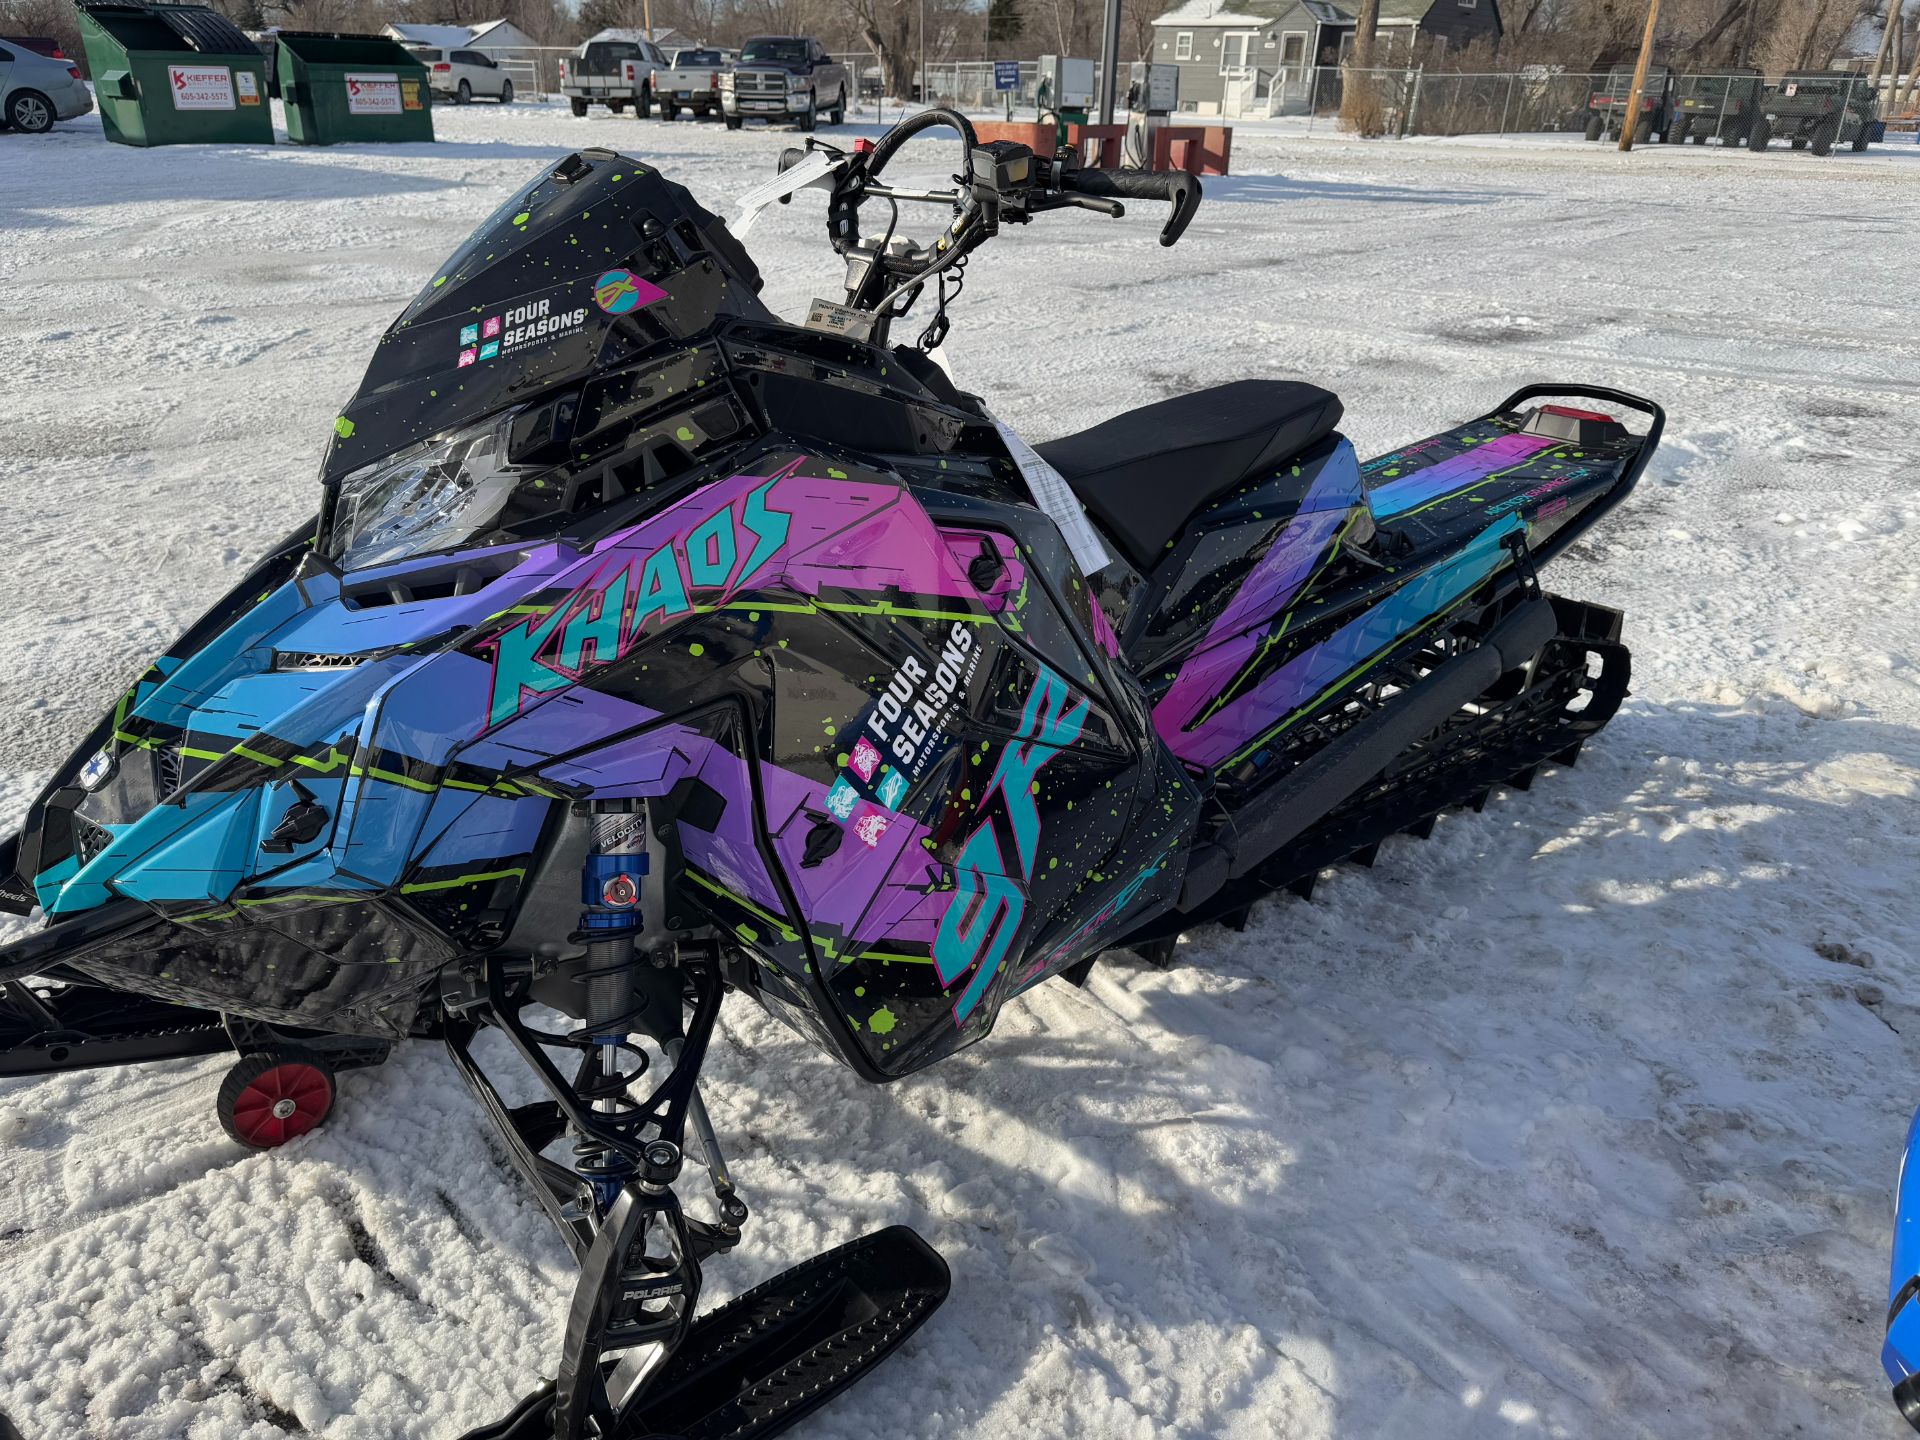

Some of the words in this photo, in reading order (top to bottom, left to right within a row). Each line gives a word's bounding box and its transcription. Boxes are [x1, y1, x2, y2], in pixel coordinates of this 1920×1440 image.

[186, 74, 227, 82] KIEFFER
[181, 92, 228, 101] 605-342-5575
[503, 308, 585, 347] SEASONS
[505, 299, 549, 328] FOUR
[501, 337, 548, 356] MOTORSPORTS
[558, 326, 584, 339] MARINE
[475, 456, 806, 740] KHAOS
[867, 655, 928, 742] FOUR
[892, 621, 972, 765] SEASONS
[912, 703, 960, 777] MOTORSPORS
[958, 690, 966, 700] &
[963, 643, 983, 687] MARINE
[601, 819, 643, 848] VELOCITY
[0, 889, 28, 902] heels
[623, 1283, 683, 1301] POLARIS
